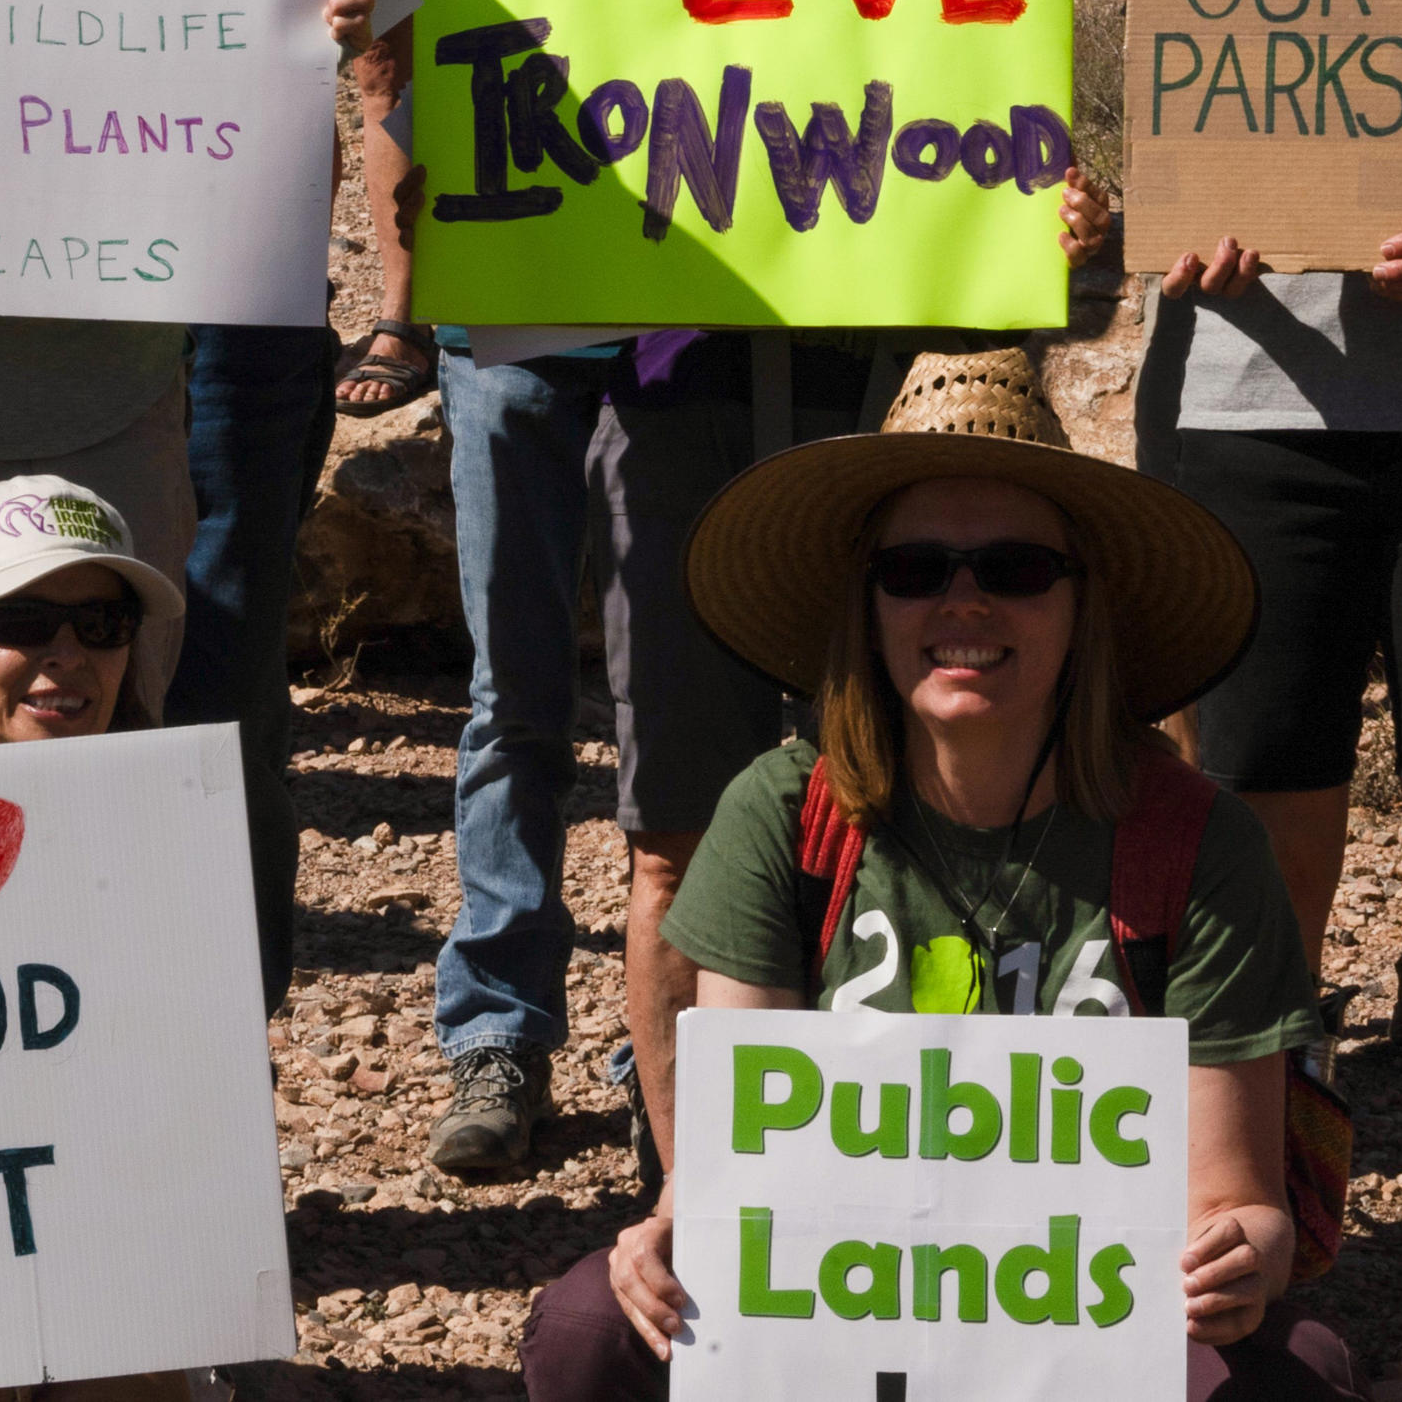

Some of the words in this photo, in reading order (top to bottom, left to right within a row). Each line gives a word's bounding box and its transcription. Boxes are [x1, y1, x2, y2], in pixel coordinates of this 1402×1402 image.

[18, 94, 241, 162] PLANTS
[432, 17, 1072, 244] IRONWOOD
[731, 1044, 1152, 1167] Public
[738, 1206, 1136, 1328] Lands
